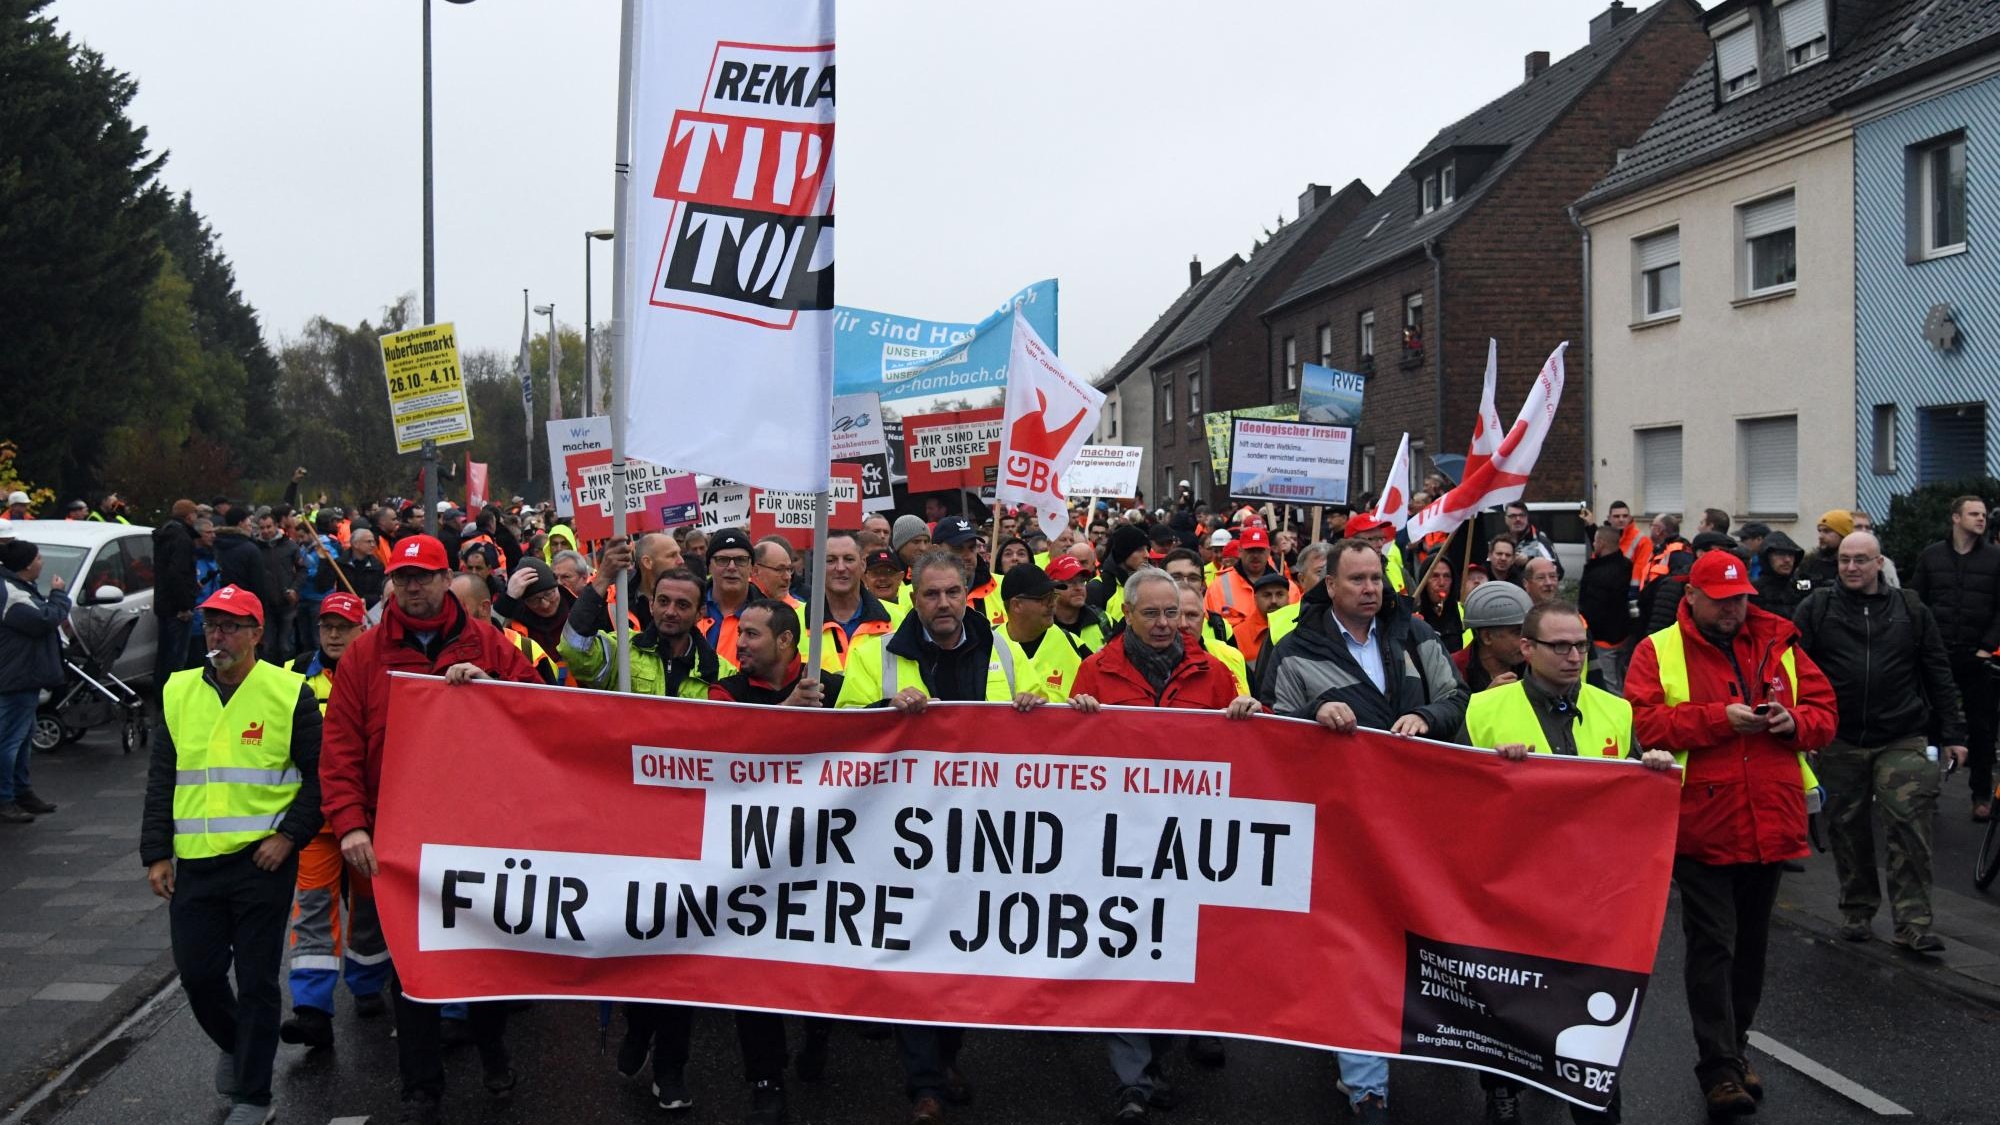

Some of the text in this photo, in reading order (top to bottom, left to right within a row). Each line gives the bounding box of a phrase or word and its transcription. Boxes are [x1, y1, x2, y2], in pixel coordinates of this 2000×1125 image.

[673, 119, 822, 206] TIP
[686, 212, 835, 300] TOP
[395, 329, 436, 343] Bergheimer
[869, 318, 921, 342] sind
[384, 334, 455, 361] Hubertusmarkt
[886, 345, 927, 358] UNSER
[1332, 372, 1364, 392] RWE
[570, 428, 590, 438] Wir
[833, 432, 858, 440] Lieber
[921, 427, 1003, 446] WIR SIND LAU
[1239, 422, 1347, 439] Ideologischer Irrsinn
[562, 441, 601, 452] machen
[832, 439, 880, 450] nkohlestrom
[913, 442, 986, 459] FÜR UNSERE
[1080, 448, 1124, 457] machen
[933, 457, 966, 469] JOBS!
[1267, 467, 1308, 476] Kohleausstieg
[588, 473, 611, 487] WIR
[625, 467, 647, 481] IND
[580, 487, 607, 503] FÜR
[862, 482, 881, 495] UT
[1268, 483, 1315, 495] VERNUNFT
[700, 491, 743, 505] JA zum
[758, 495, 833, 512] FÜR UNSEE
[723, 514, 741, 523] zum
[778, 512, 812, 525] JOBS!
[641, 754, 1221, 797] OHNE GUTE ARBEIT KEIN GUTES KLIMA!
[731, 804, 1291, 886] WIR SIND LAUT
[441, 857, 1165, 960] FÜR UNSERE JOBS!
[1419, 949, 1548, 989] GEMEINSCHAFT.
[1421, 963, 1472, 995] MACHT.
[1420, 981, 1492, 1017] ZUKUNFT.
[1437, 1024, 1543, 1063] Zukunftsgewerkschaft
[1417, 1033, 1544, 1072] Bergbau, Chemie, Energie
[1555, 1060, 1616, 1093] IG BCE
